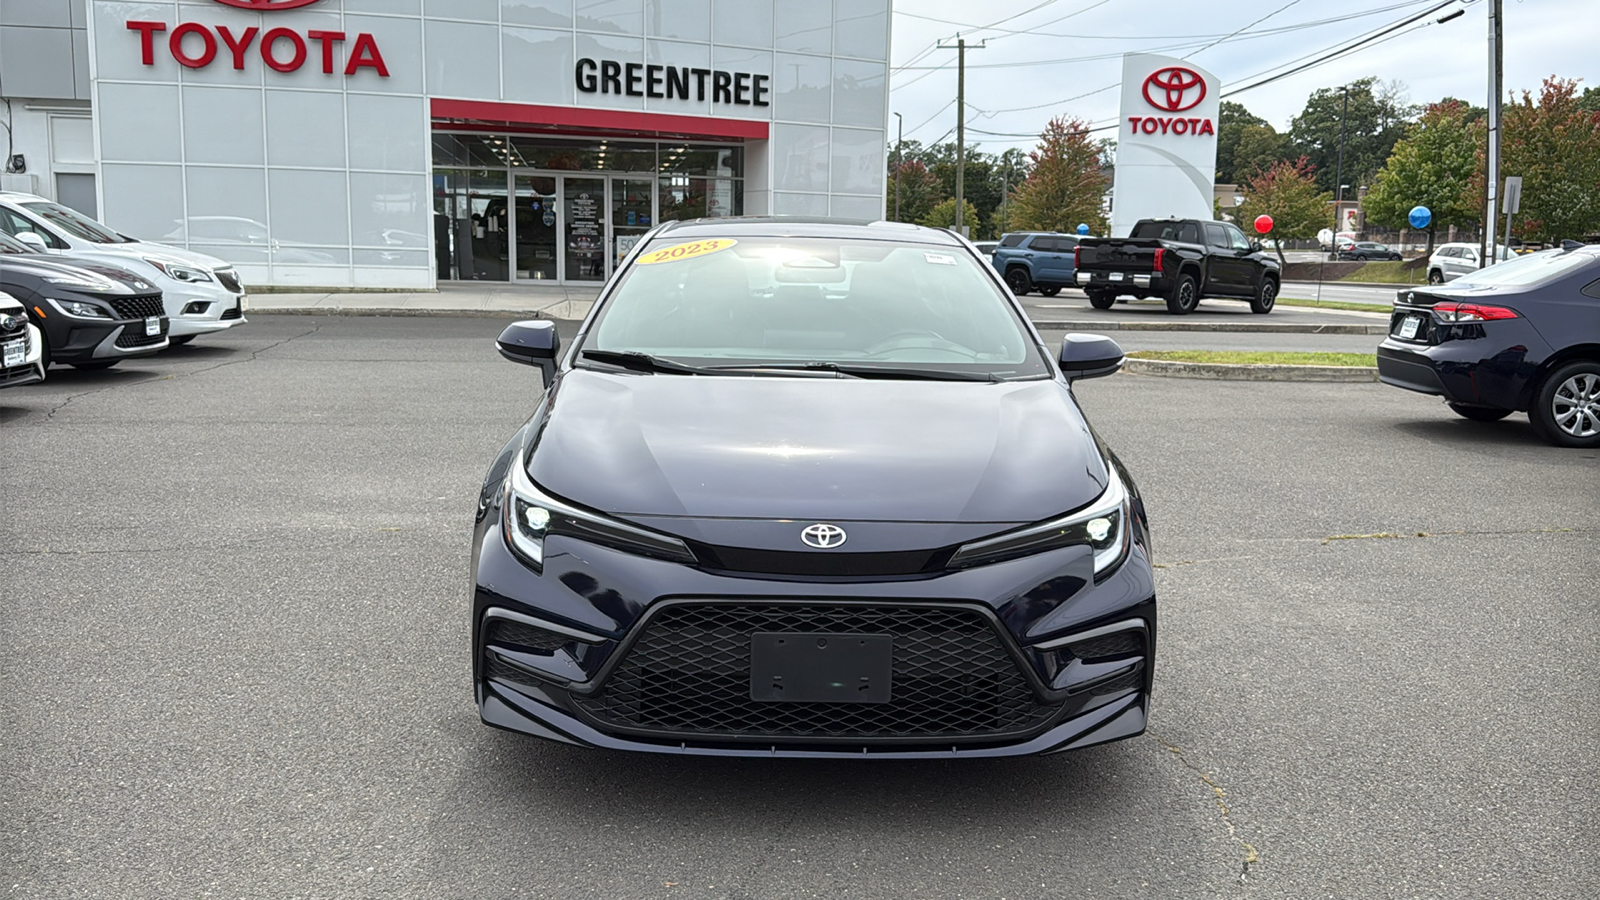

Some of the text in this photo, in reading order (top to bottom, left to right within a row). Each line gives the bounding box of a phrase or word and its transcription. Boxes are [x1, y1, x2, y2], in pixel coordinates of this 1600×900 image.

[126, 20, 390, 77] TOYOTA
[575, 57, 769, 107] GREENTREE
[1128, 116, 1214, 136] TOYOTA
[654, 240, 719, 262] 2023
